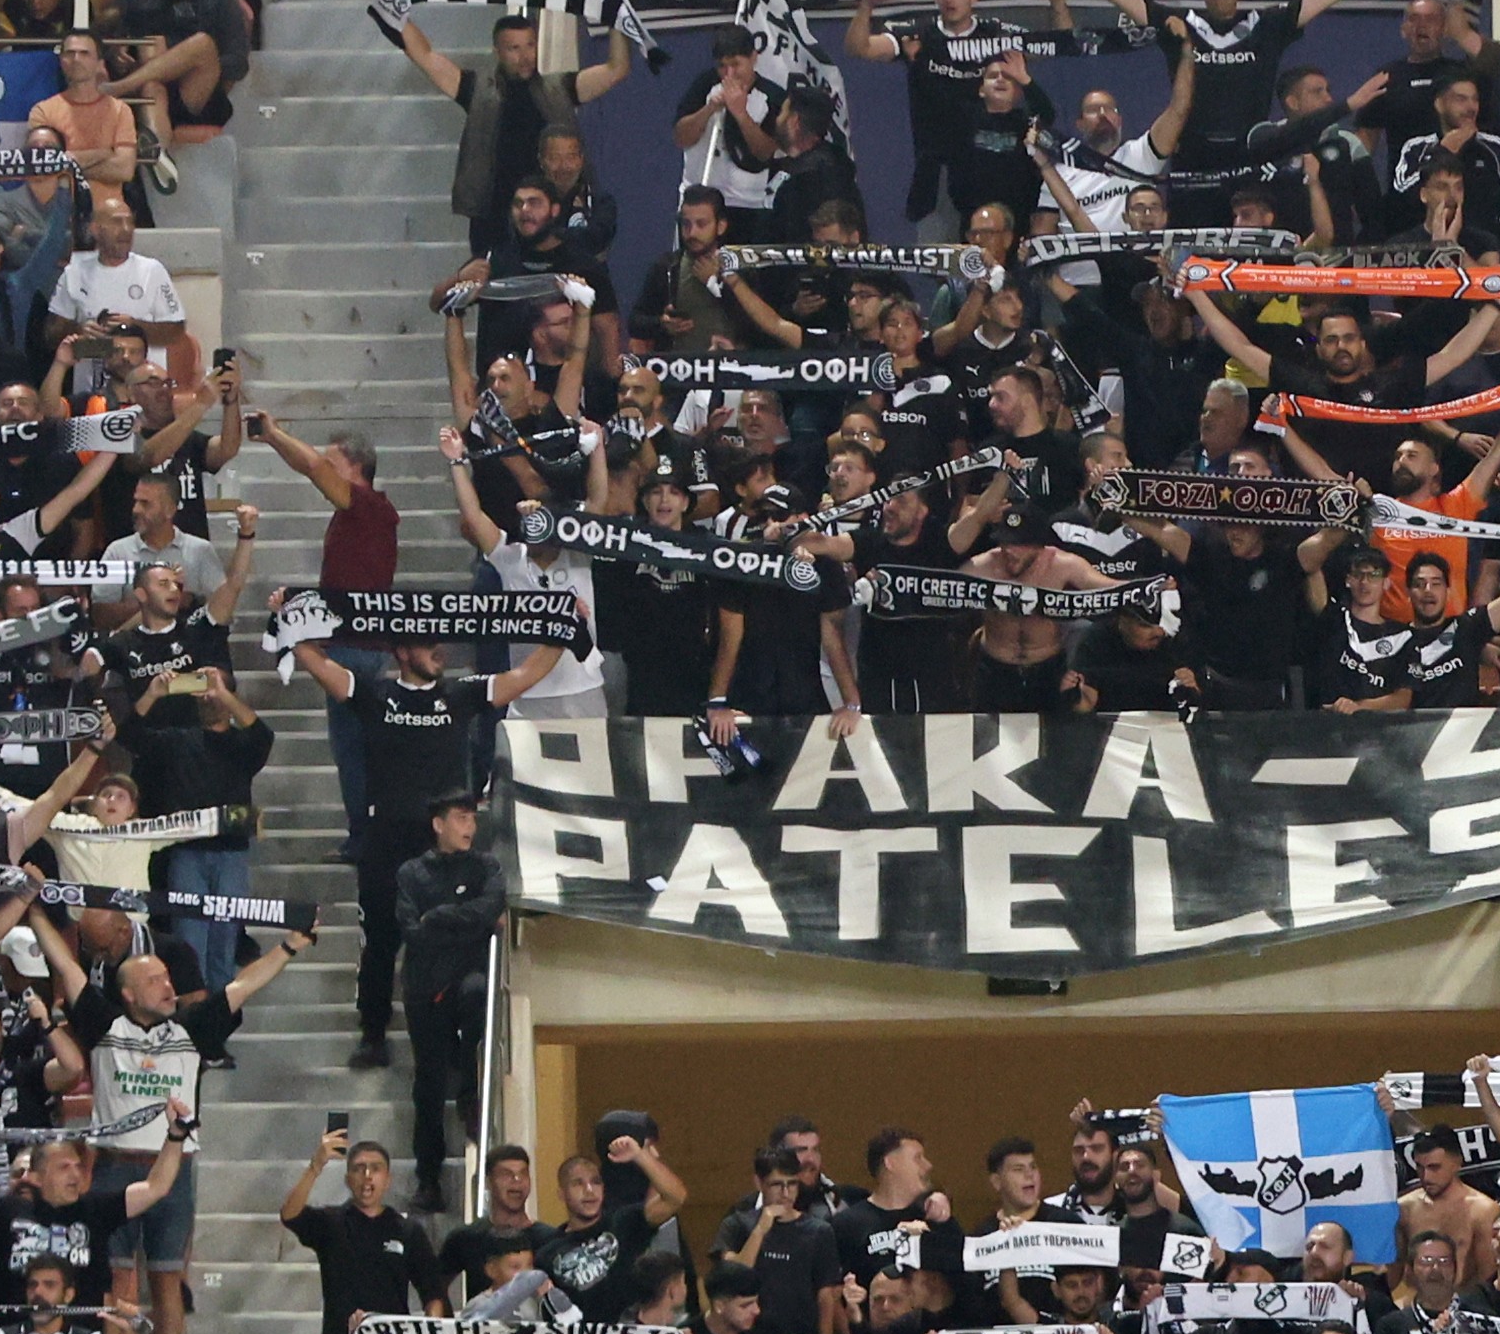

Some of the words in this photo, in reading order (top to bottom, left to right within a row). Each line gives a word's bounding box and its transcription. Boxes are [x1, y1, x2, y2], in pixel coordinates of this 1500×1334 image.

[644, 356, 716, 383] ΟΦΗ
[799, 356, 871, 383] ΟΦΗ
[0, 425, 39, 445] FC
[1138, 480, 1218, 509] FORZA
[556, 516, 628, 553] ΟΦΗ
[712, 546, 785, 579] ΟΦΗ
[895, 576, 920, 594] OFI
[921, 578, 963, 598] CRETE
[965, 581, 989, 600] FC
[1045, 593, 1072, 608] OFI
[1074, 589, 1118, 608] CRETE
[1120, 588, 1140, 605] FC
[347, 591, 407, 617] THIS
[413, 592, 435, 617] IS
[441, 592, 513, 618] GENTI
[28, 602, 80, 633] FC
[350, 615, 384, 638] OFI
[387, 617, 457, 639] CRETE
[461, 618, 491, 640] FC
[503, 618, 554, 640] SINCE
[383, 710, 451, 727] betsson
[112, 1071, 183, 1088] MINOAN
